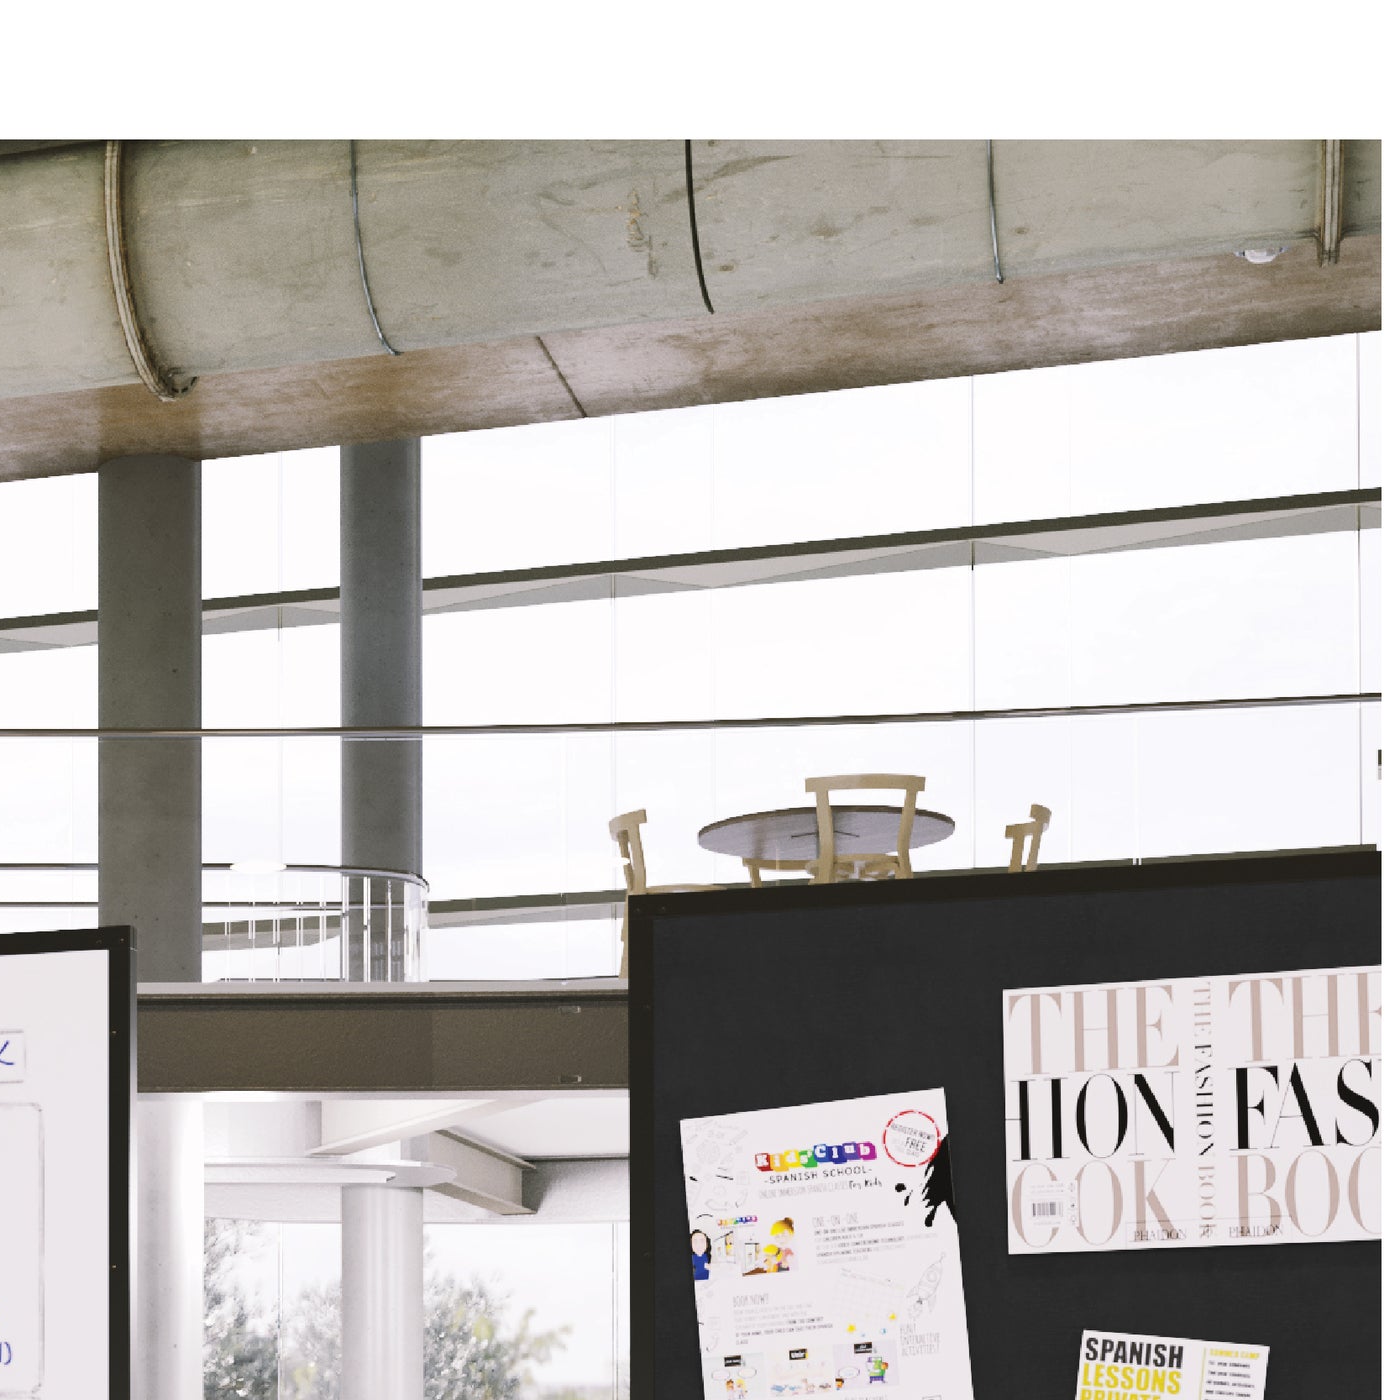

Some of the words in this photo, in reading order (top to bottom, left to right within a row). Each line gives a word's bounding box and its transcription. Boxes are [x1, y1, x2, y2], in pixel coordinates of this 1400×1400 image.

[1009, 985, 1180, 1074] THE
[1086, 1338, 1183, 1369] SPANISH
[1082, 1363, 1181, 1394] LESSONS
